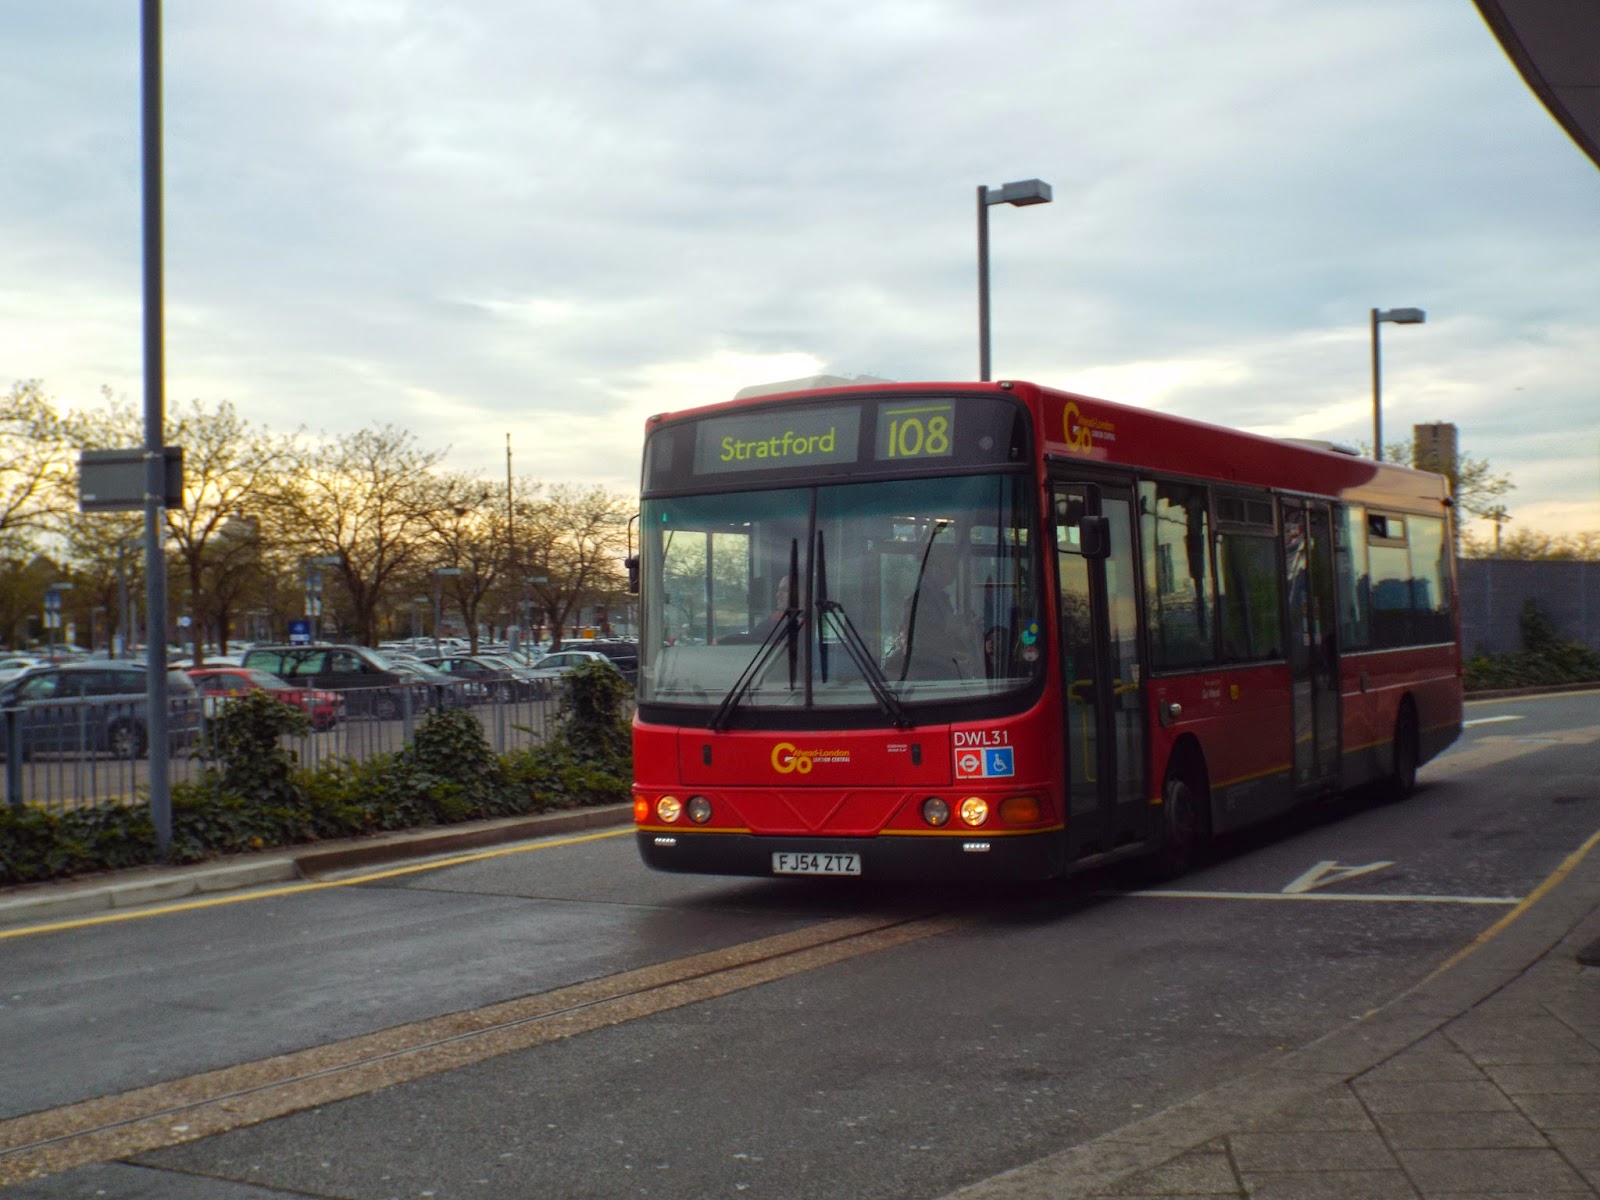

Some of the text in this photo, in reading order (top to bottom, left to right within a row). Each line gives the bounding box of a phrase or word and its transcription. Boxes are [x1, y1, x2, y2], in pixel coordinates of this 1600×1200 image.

[720, 427, 835, 462] Stratford
[888, 416, 949, 457] 108
[1063, 401, 1092, 455] Go
[954, 730, 1008, 746] DWL31
[771, 742, 812, 774] Go
[779, 854, 855, 872] FJ54 ZTZ
